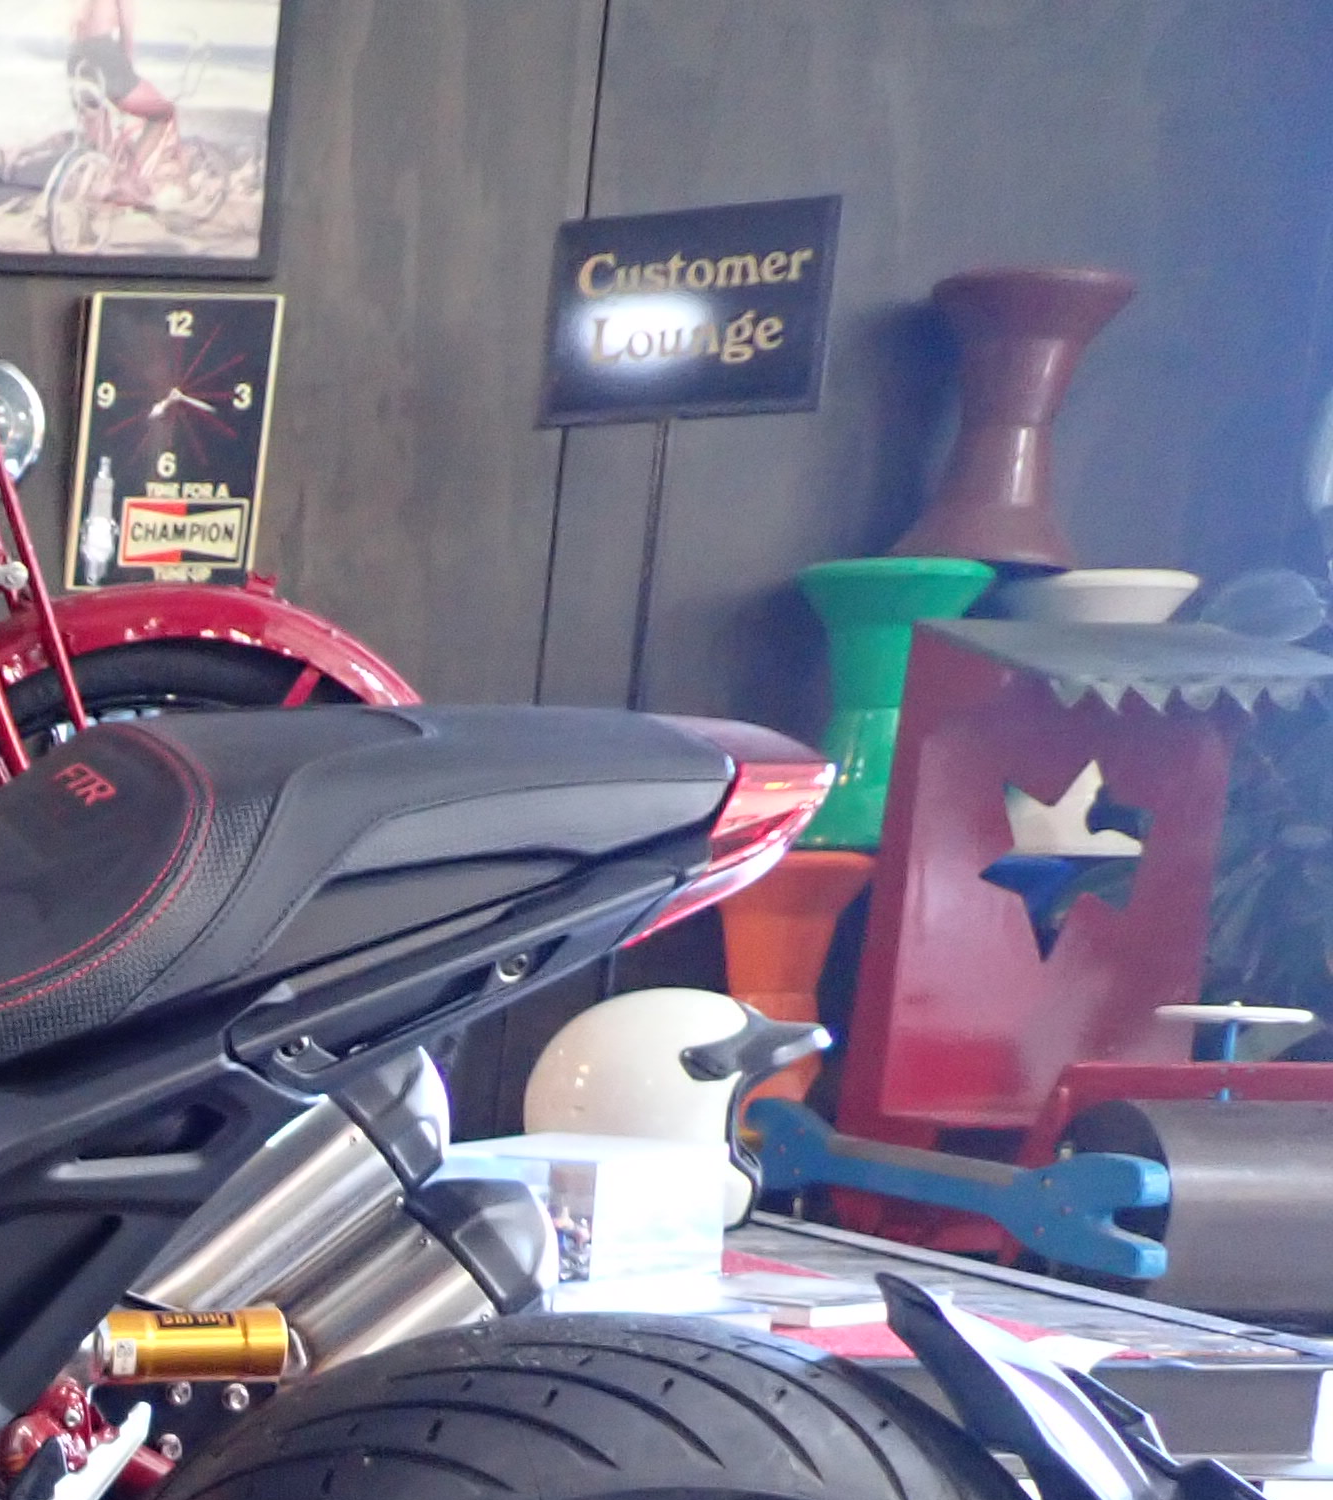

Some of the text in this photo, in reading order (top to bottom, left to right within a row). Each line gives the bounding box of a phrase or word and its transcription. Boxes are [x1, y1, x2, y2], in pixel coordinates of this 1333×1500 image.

[577, 248, 814, 298] Customer
[165, 310, 194, 338] 12
[589, 309, 784, 366] Lounge
[96, 381, 117, 409] 9
[232, 382, 253, 410] 3
[156, 451, 177, 478] 6
[214, 481, 231, 498] A
[131, 522, 235, 544] CHAMPION
[53, 762, 117, 808] FTR
